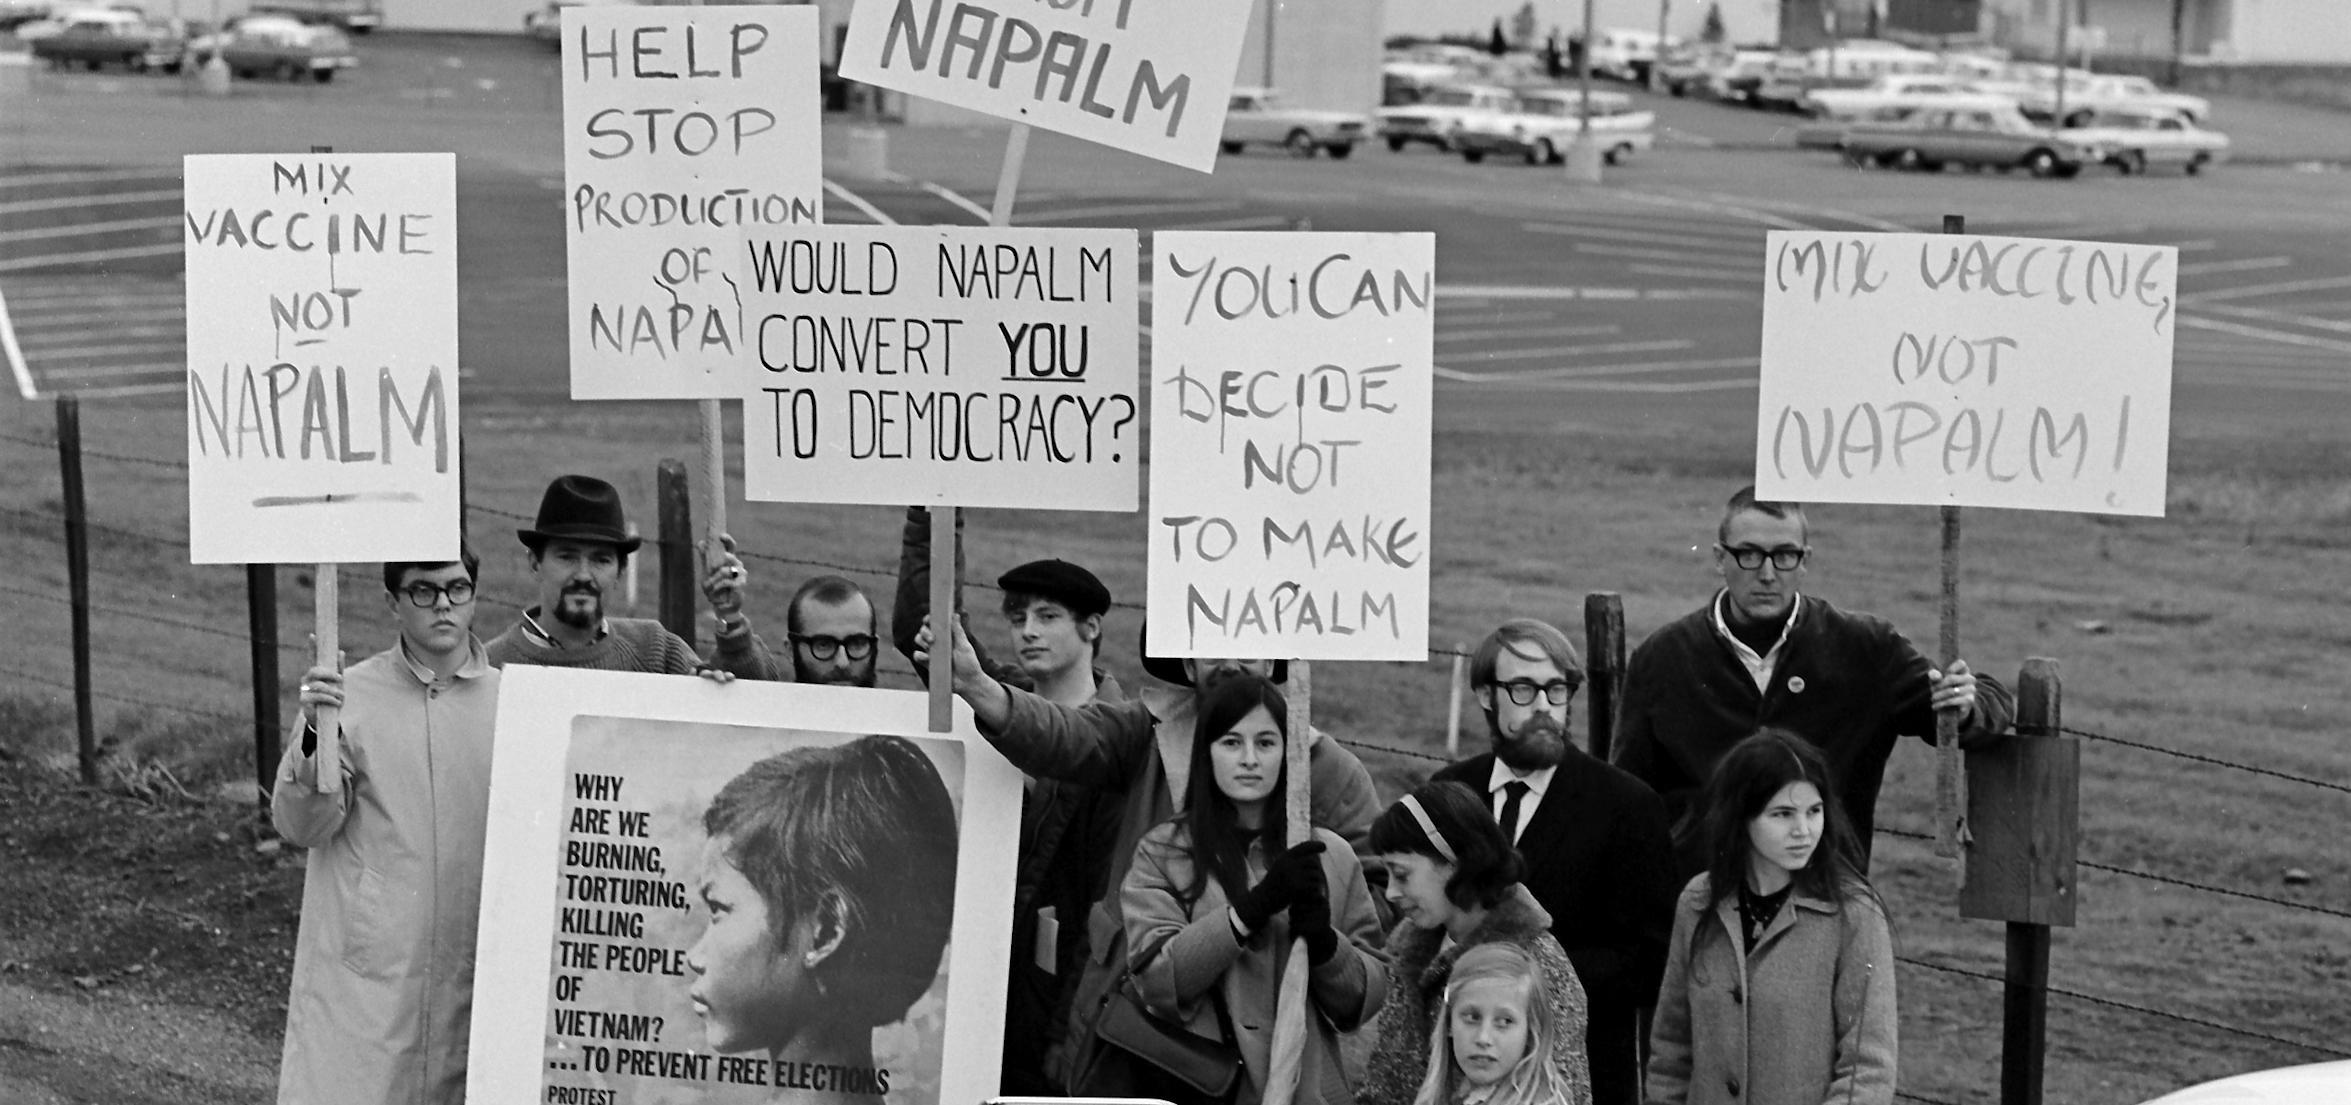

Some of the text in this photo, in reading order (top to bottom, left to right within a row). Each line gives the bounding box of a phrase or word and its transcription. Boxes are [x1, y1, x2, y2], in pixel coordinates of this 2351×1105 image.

[581, 23, 768, 82] HELP
[880, 0, 1190, 138] NAPALM
[586, 107, 776, 159] STOP
[274, 161, 353, 195] MIX
[187, 209, 432, 254] VACCINE
[574, 183, 816, 232] PRODUCTION
[660, 247, 712, 285] OF
[749, 240, 1112, 303] WOULD NAPALM
[1777, 240, 2170, 335] MIX VACCINE,
[270, 289, 362, 332] NOT
[591, 303, 743, 360] NAPA
[759, 314, 1088, 377] CONVERT YOU
[1893, 332, 2017, 386] NOT
[190, 362, 447, 473] NAPALM
[1163, 364, 1401, 423] DECIDE
[762, 388, 1135, 463] TO DEMOCRACY?
[1244, 439, 1361, 494] NOT
[1774, 395, 2131, 507] NAPALM!
[1162, 515, 1422, 569] TO MAKE
[1188, 581, 1399, 648] NAPALM
[575, 773, 624, 802] WHY
[570, 807, 650, 838] ARE WE
[566, 840, 666, 878] BURNING,
[565, 874, 691, 914] TORTURING,
[561, 907, 644, 939] KILLING
[559, 941, 686, 976] THE PEOPLE
[556, 975, 583, 1002] OF
[555, 1009, 664, 1043] VIETNAM?
[547, 1085, 617, 1105] PROTEST
[616, 1048, 712, 1081] PREVENT
[717, 1056, 769, 1086] FREE
[775, 1060, 890, 1096] ELECTIONS
